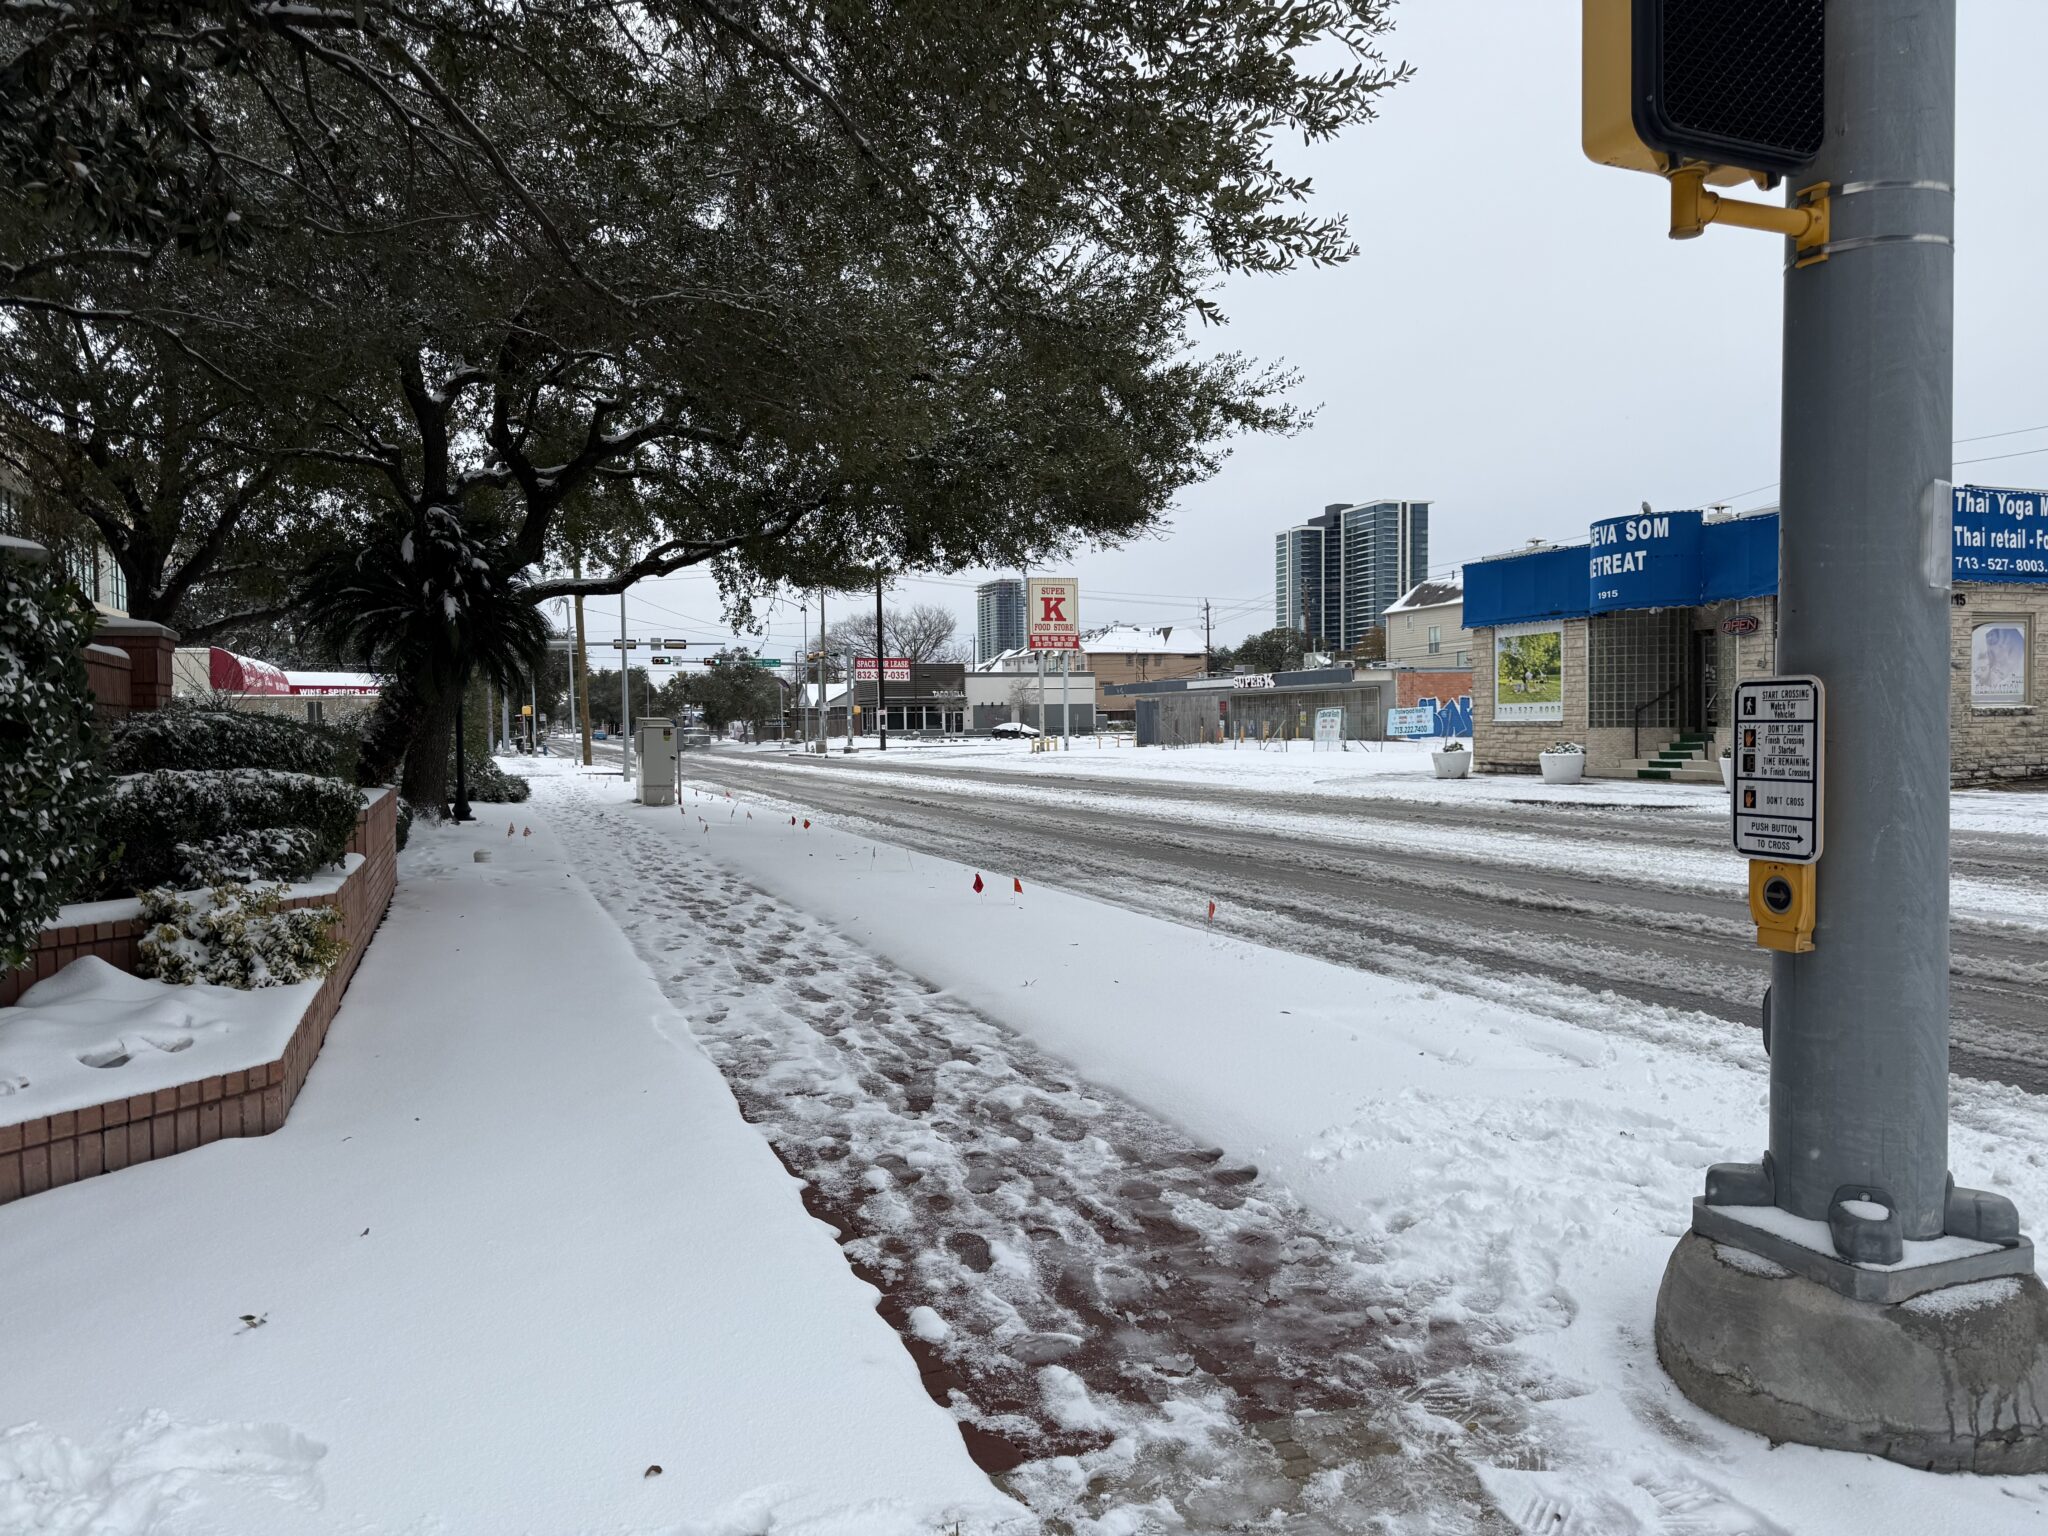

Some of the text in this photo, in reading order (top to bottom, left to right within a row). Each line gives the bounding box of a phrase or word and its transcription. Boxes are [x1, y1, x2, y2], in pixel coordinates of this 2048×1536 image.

[1955, 491, 1990, 514] Thai
[1996, 493, 2034, 520] Yoga
[1625, 517, 1669, 542] SOM
[1954, 526, 1986, 547] Thai
[1990, 528, 2026, 548] retail
[1041, 586, 1066, 595] SUPER
[1598, 589, 1618, 600] 1915
[1040, 596, 1067, 622] K
[1054, 624, 1074, 632] STORE
[1722, 618, 1757, 631] OPEN
[857, 671, 909, 679] 832-37-0351
[1762, 689, 1809, 699] START CROSSING
[1770, 701, 1796, 710] Watch For
[1774, 710, 1796, 719] Vehicles
[1768, 724, 1804, 733] DON'T START
[1765, 736, 1805, 747] Finish Crossing
[1778, 746, 1796, 754] Started
[1763, 757, 1810, 767] TIME REMAINING
[1761, 767, 1767, 775] To
[1770, 767, 1786, 776] Finish
[1788, 767, 1810, 779] Crossing
[1766, 796, 1804, 807] DON'T CROSS
[1751, 822, 1798, 834] PUSH BUTTON
[1757, 839, 1790, 851] TO CROSS
